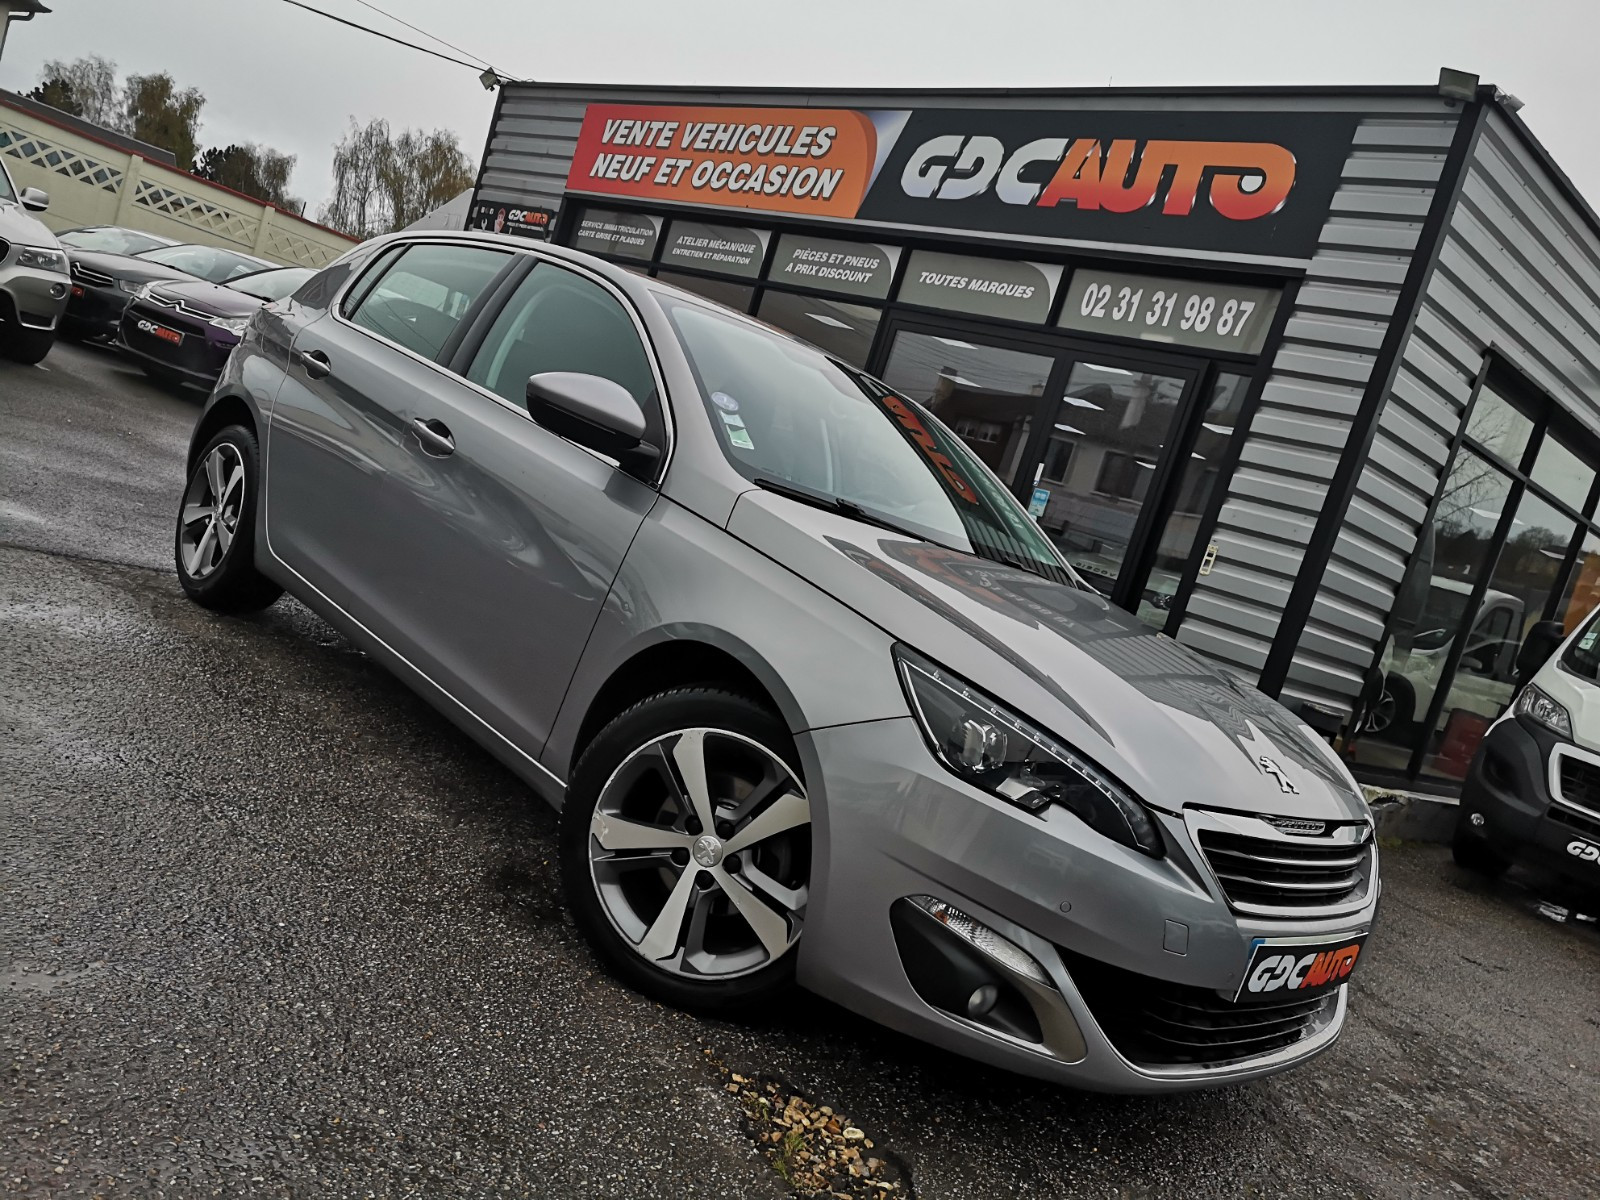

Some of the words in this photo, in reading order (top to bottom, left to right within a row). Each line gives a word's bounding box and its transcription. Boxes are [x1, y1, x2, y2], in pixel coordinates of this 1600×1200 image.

[601, 119, 679, 147] VENTE
[680, 122, 837, 157] VEHICULES
[589, 153, 657, 182] NEUF
[653, 157, 693, 186] ET
[691, 160, 844, 199] OCCASION
[578, 229, 596, 238] CARTE
[595, 232, 612, 241] GRISE
[619, 235, 646, 246] PLAQUES
[581, 220, 604, 230] SERVICE
[603, 223, 655, 237] IMMATRICULATION
[676, 235, 709, 248] ATELIER
[708, 239, 757, 254] MÉCANIQUE
[672, 248, 704, 258] ENTRETIEN
[711, 252, 751, 265] RÉPARATION
[792, 248, 829, 262] PIÈCES
[828, 253, 844, 264] ET
[843, 255, 880, 269] PNEUS
[784, 262, 794, 272] A
[794, 263, 820, 276] PRIX
[818, 266, 872, 283] DISCOUNT
[919, 272, 969, 289] TOUTES
[968, 279, 1035, 299] MARQUES
[1081, 282, 1112, 318] 02
[1112, 286, 1144, 322] 31
[1145, 290, 1178, 327] 31
[1180, 294, 1215, 332] 98
[1216, 299, 1256, 337] 87
[1567, 841, 1600, 866] GD
